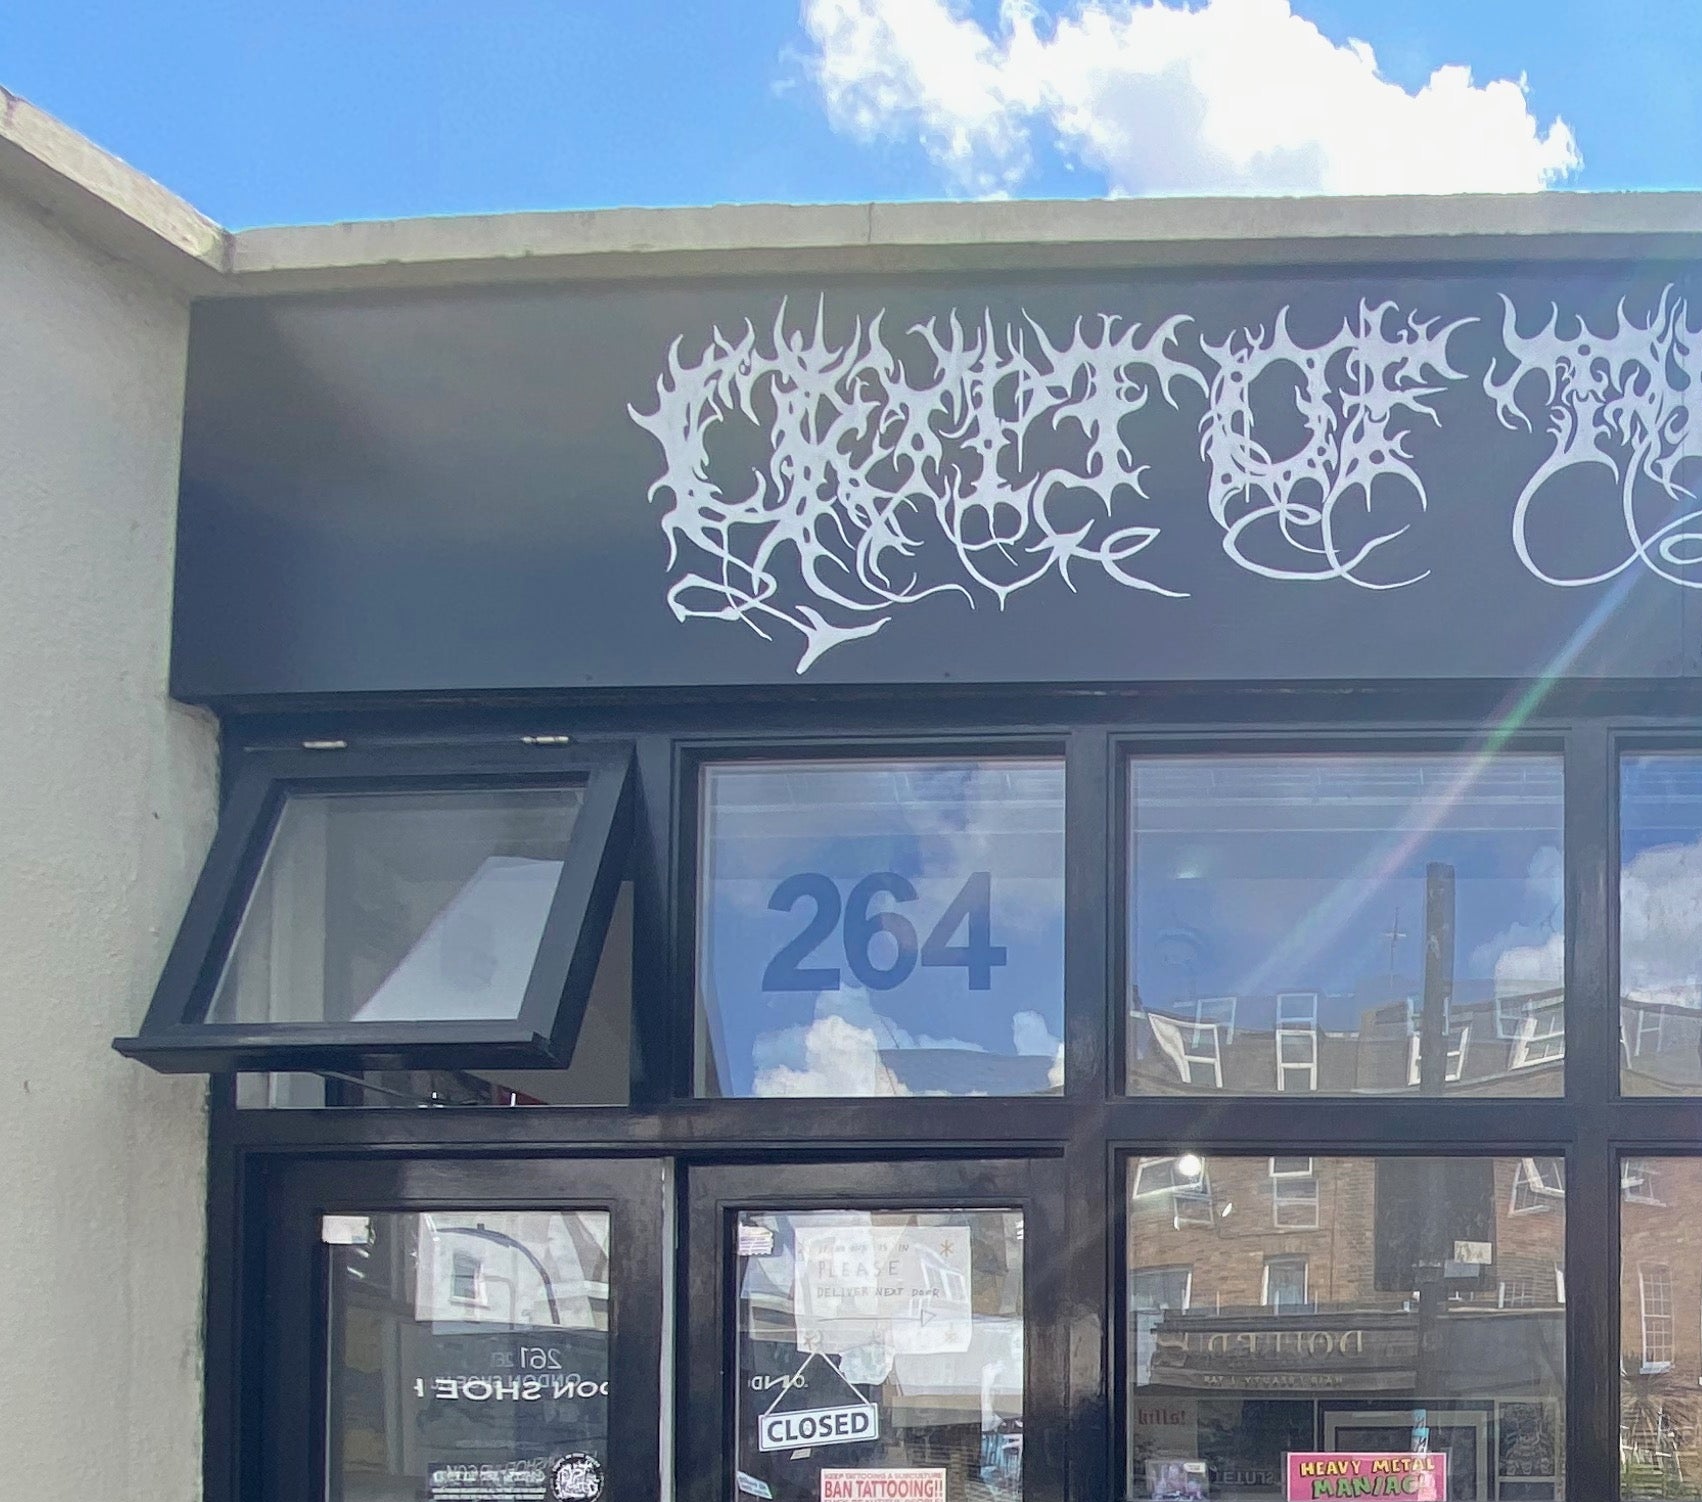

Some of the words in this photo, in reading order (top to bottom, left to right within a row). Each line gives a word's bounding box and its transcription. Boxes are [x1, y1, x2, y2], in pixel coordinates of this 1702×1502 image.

[1200, 299, 1480, 589] OF
[762, 871, 1007, 991] 264
[818, 1259, 900, 1279] PLEASE
[816, 1286, 871, 1299] DELIVER
[875, 1286, 905, 1298] NEXT
[767, 1412, 870, 1443] CLOSED
[1300, 1459, 1362, 1478] HEAVY
[1371, 1457, 1436, 1475] METAL
[824, 1480, 853, 1498] BAN
[856, 1480, 943, 1498] TATTOOING!!
